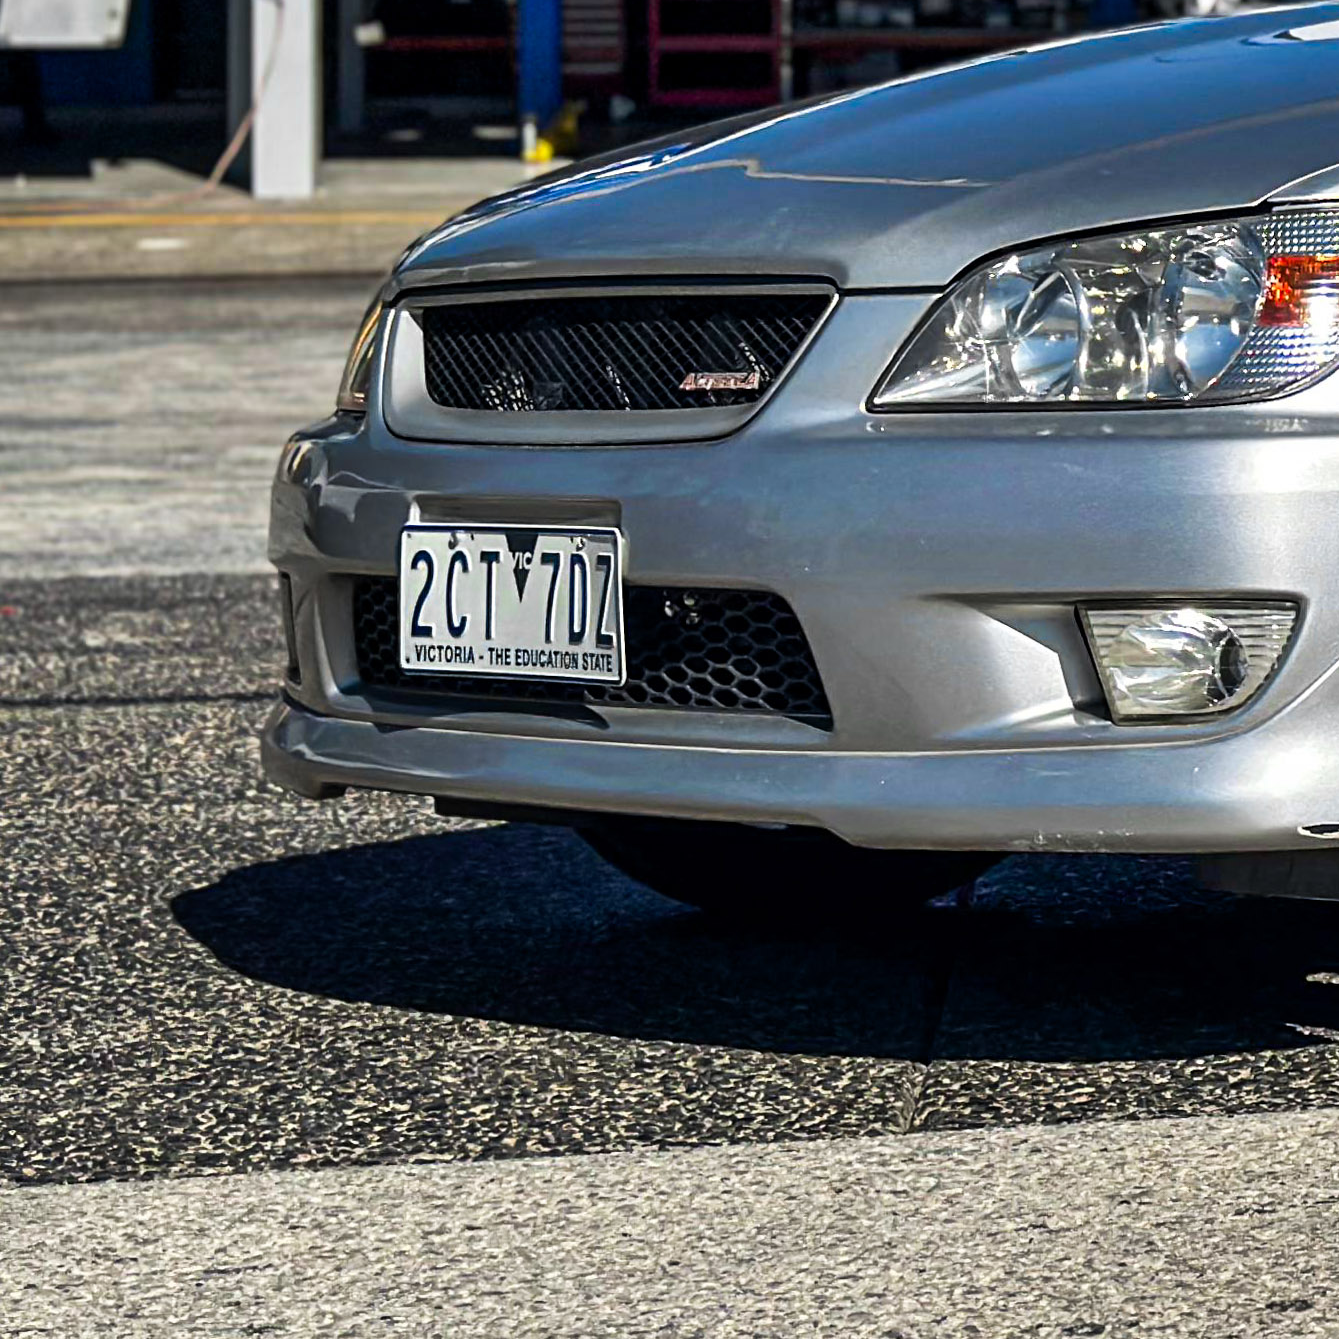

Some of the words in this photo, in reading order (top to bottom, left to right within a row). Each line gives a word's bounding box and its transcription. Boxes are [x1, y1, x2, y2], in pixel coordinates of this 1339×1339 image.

[508, 551, 533, 571] VIC
[410, 549, 502, 641] 2CT
[540, 551, 616, 649] 7DZ
[414, 644, 475, 665] VICTORIA
[488, 647, 512, 666] THE
[515, 649, 579, 670] EDUCATION
[582, 652, 614, 673] STATE
